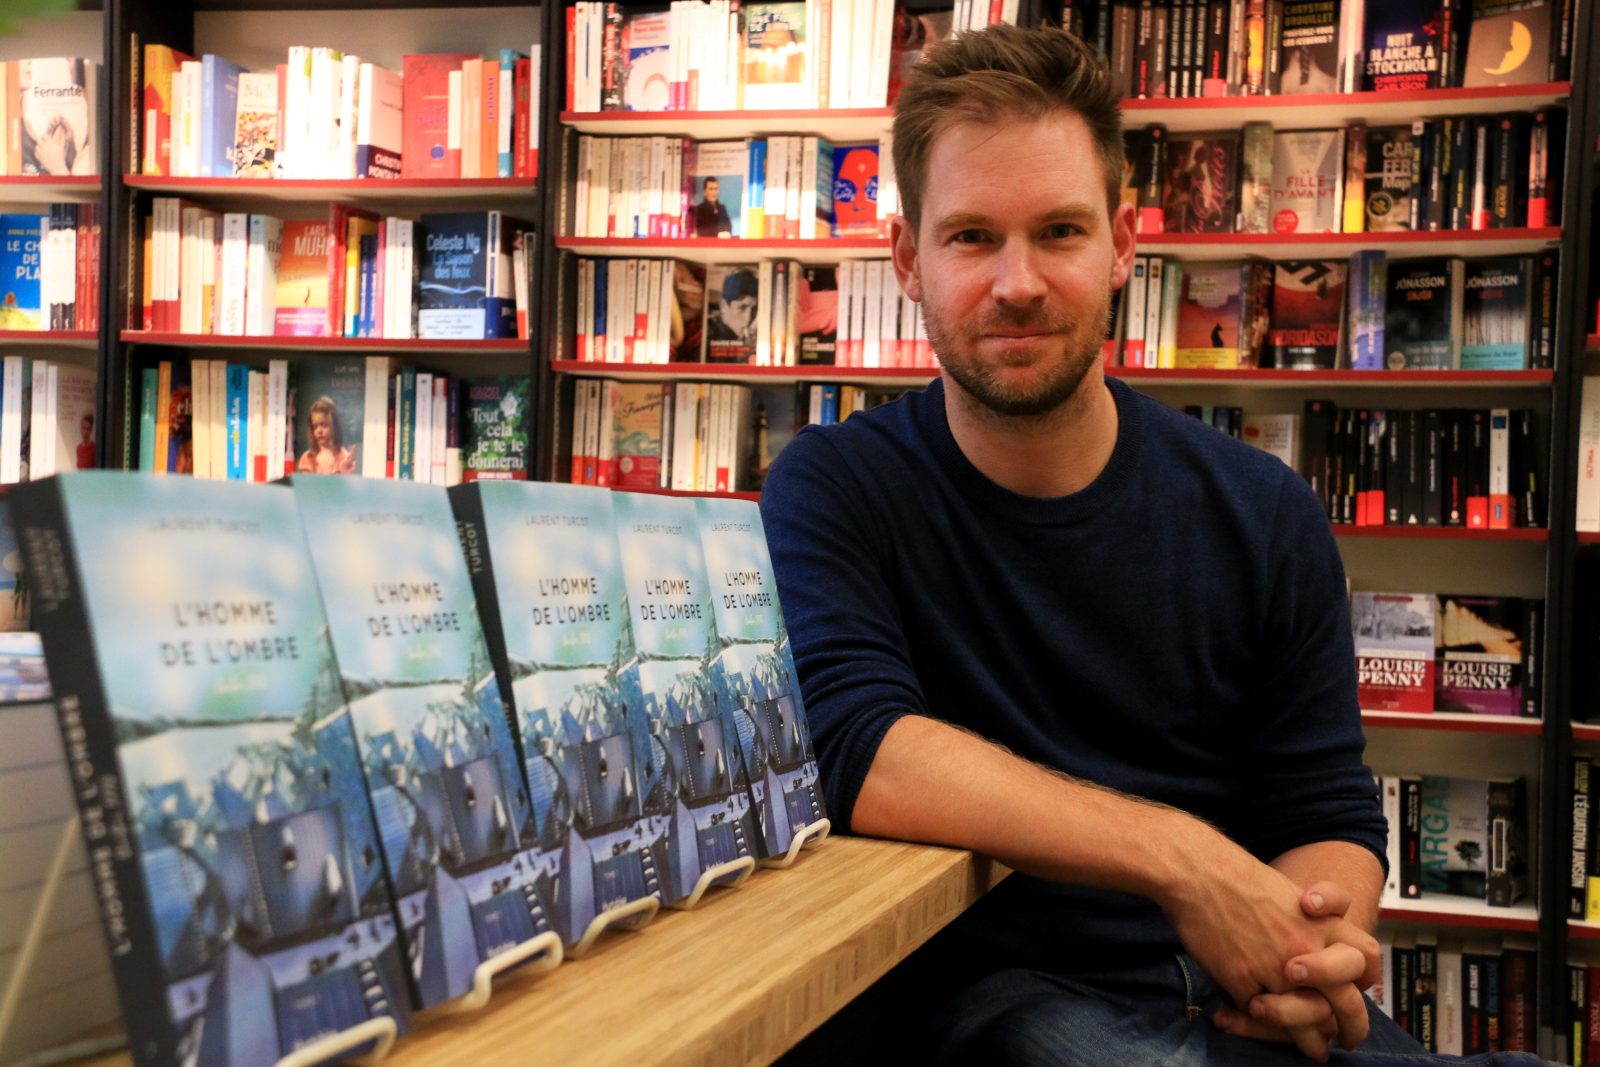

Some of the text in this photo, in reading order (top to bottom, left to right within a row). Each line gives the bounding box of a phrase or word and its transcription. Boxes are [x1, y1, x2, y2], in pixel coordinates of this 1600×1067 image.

[1371, 46, 1422, 61] BLANCHE
[1366, 58, 1438, 75] STOCKHOLM
[34, 86, 82, 97] Ferrante
[1382, 142, 1413, 157] CAR
[1286, 176, 1325, 187] FILLE
[1274, 188, 1335, 199] D'AVANT
[7, 241, 41, 252] LE CH
[427, 233, 480, 254] Celeste Ng
[22, 254, 38, 265] DE
[446, 251, 474, 265] Saison
[16, 266, 41, 280] PLA
[434, 265, 472, 279] des feux
[472, 408, 498, 423] Tout
[487, 421, 513, 437] cela
[476, 436, 524, 455] je te le
[468, 452, 524, 469] donnerai
[525, 515, 589, 527] LAURENT TURCOT
[632, 524, 660, 533] LAURENT
[466, 522, 482, 573] TURCOT
[725, 571, 763, 586] L'HOMME
[373, 582, 443, 604] L'HOMME
[538, 577, 598, 597] L'HOMME
[645, 579, 691, 595] L'HOMME
[723, 592, 772, 609] DE L'OMBRE
[172, 601, 278, 628] L'HOMME
[532, 603, 611, 625] DE L'OMBRE
[640, 603, 702, 620] DE L'OMBRE
[368, 612, 461, 637] DE L'OMBRE
[161, 637, 300, 667] DE L'OMBRE
[1358, 658, 1426, 673] LOUISE
[1442, 661, 1512, 676] LOUISE
[1358, 671, 1425, 687] PENNY
[1442, 674, 1511, 690] PENNY
[1421, 777, 1449, 893] VARGAS
[1571, 794, 1590, 889] L'ÉQUATION JANSON
[1422, 1004, 1431, 1041] CHALEUR
[1590, 1002, 1599, 1038] NICOLE
